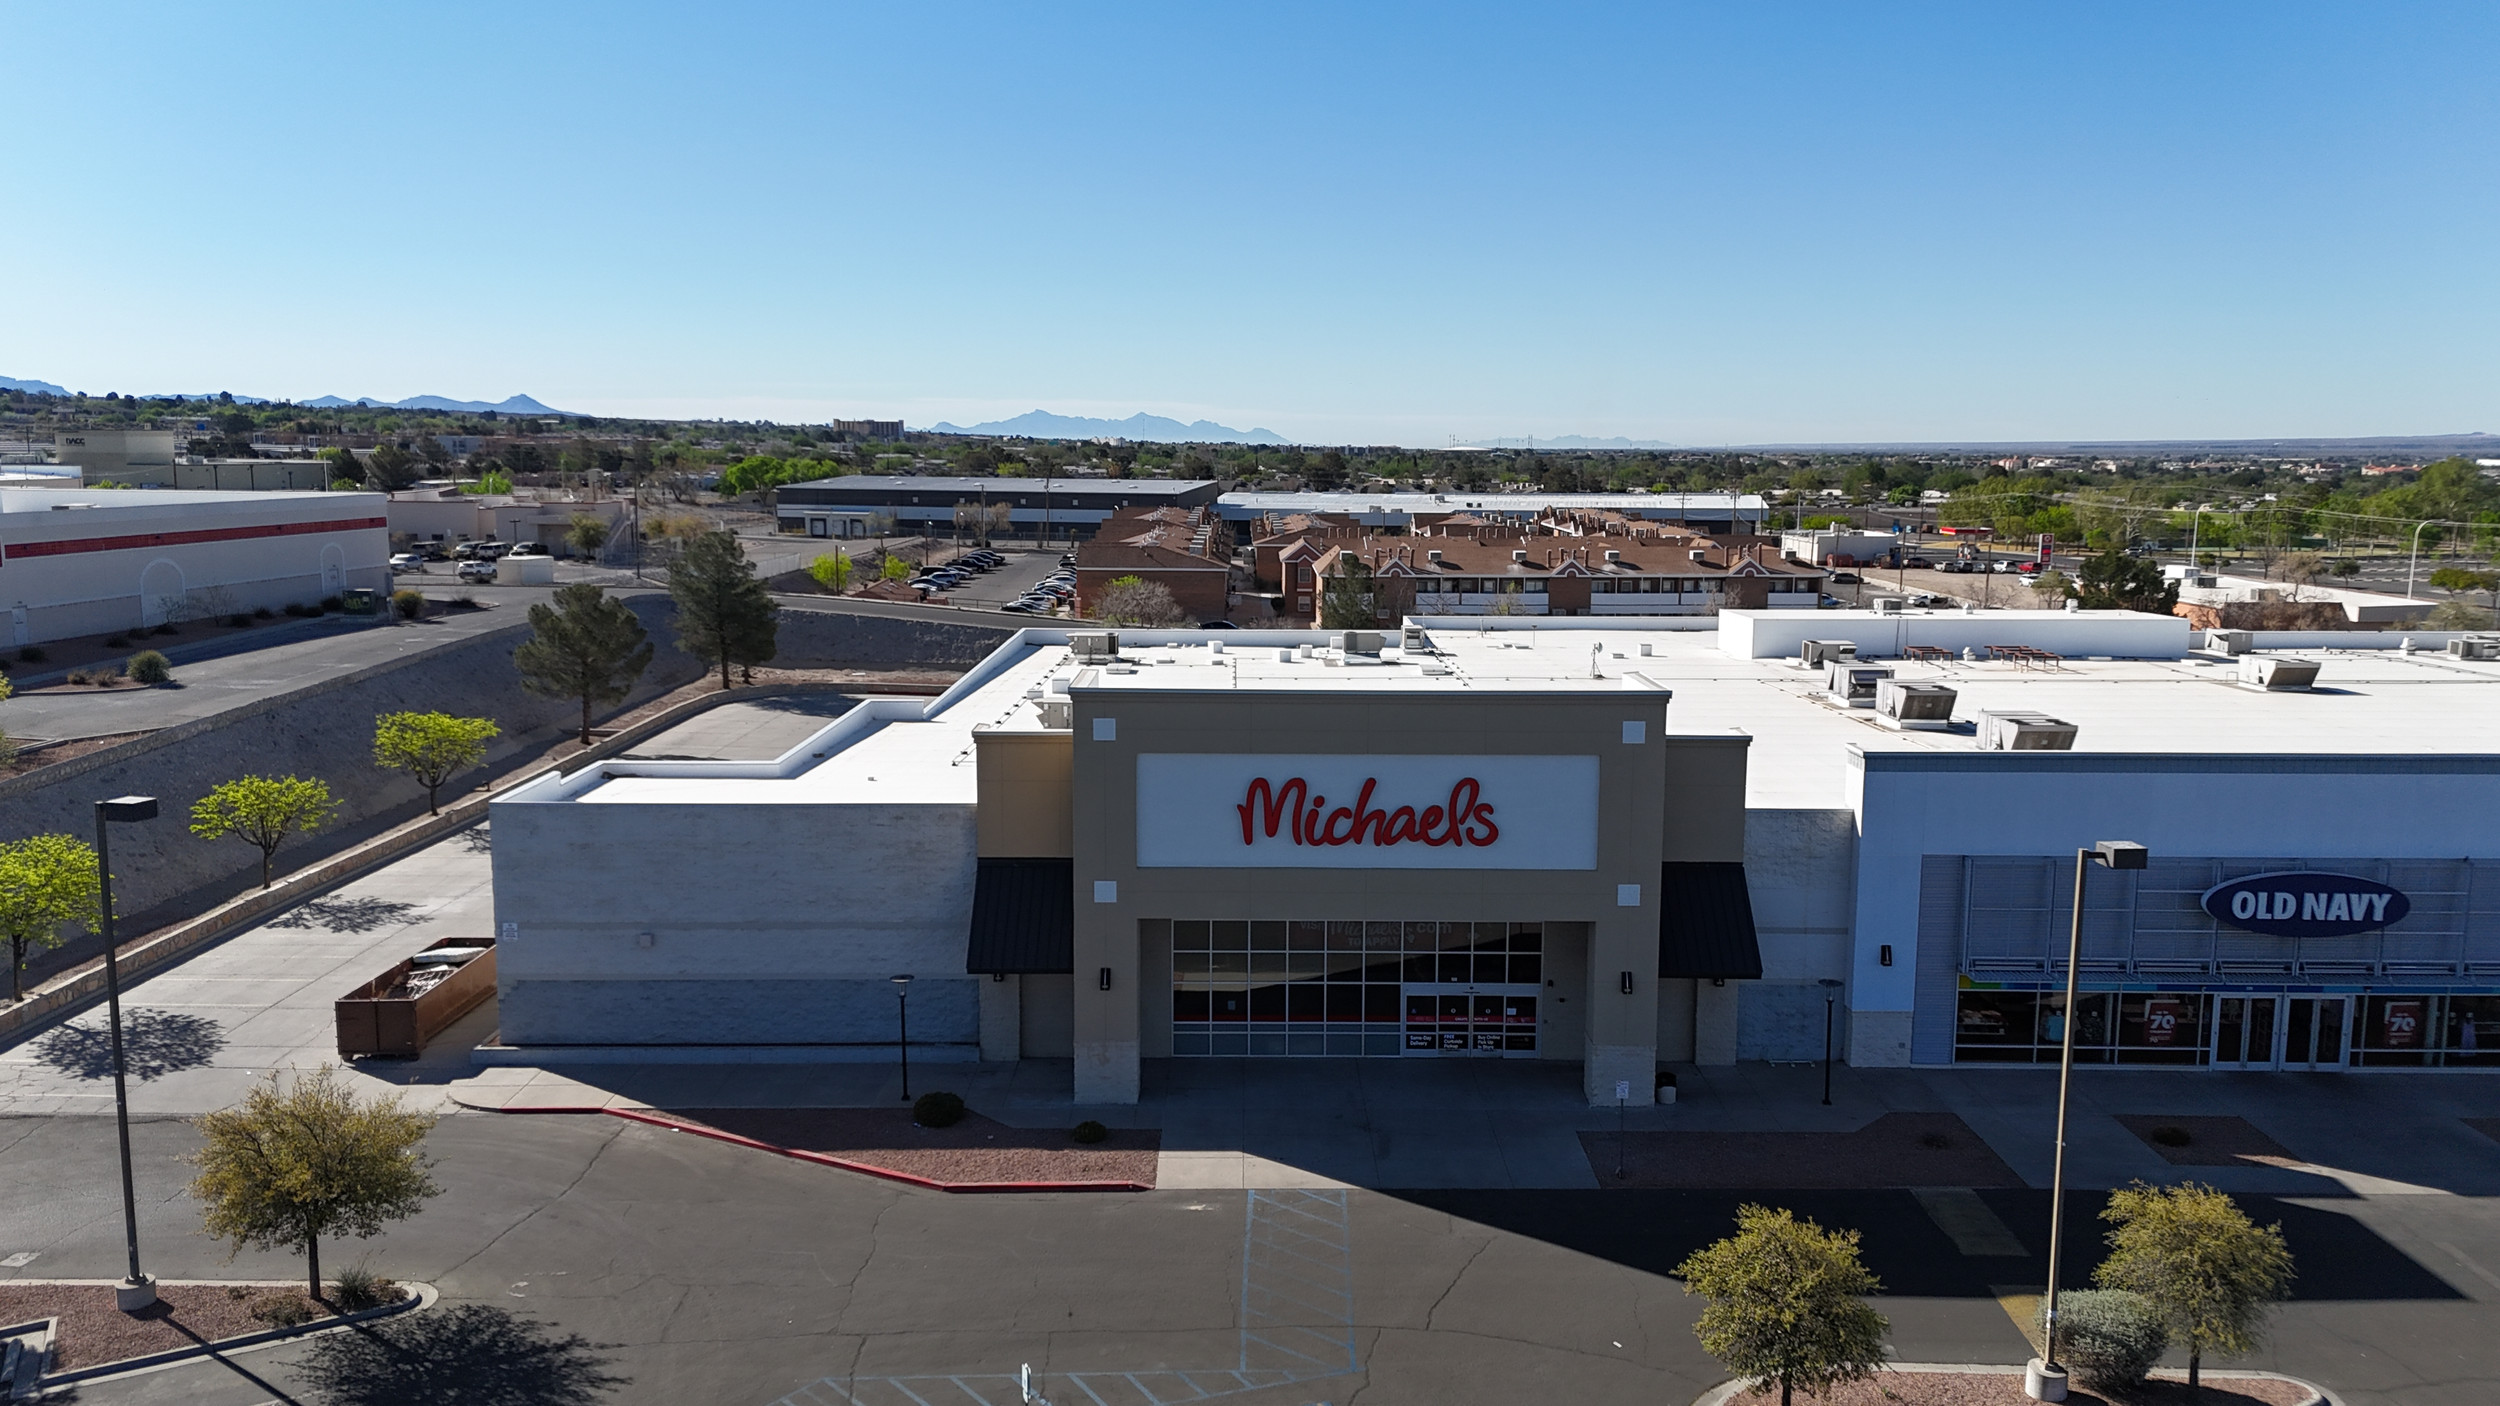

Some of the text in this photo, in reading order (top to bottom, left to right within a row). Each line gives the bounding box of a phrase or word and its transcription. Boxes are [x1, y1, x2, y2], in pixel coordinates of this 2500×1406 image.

[1237, 778, 1499, 846] Michaels
[2231, 890, 2392, 922] OLD NAVY
[2150, 1015, 2176, 1029] 70
[2390, 1017, 2416, 1031] 70
